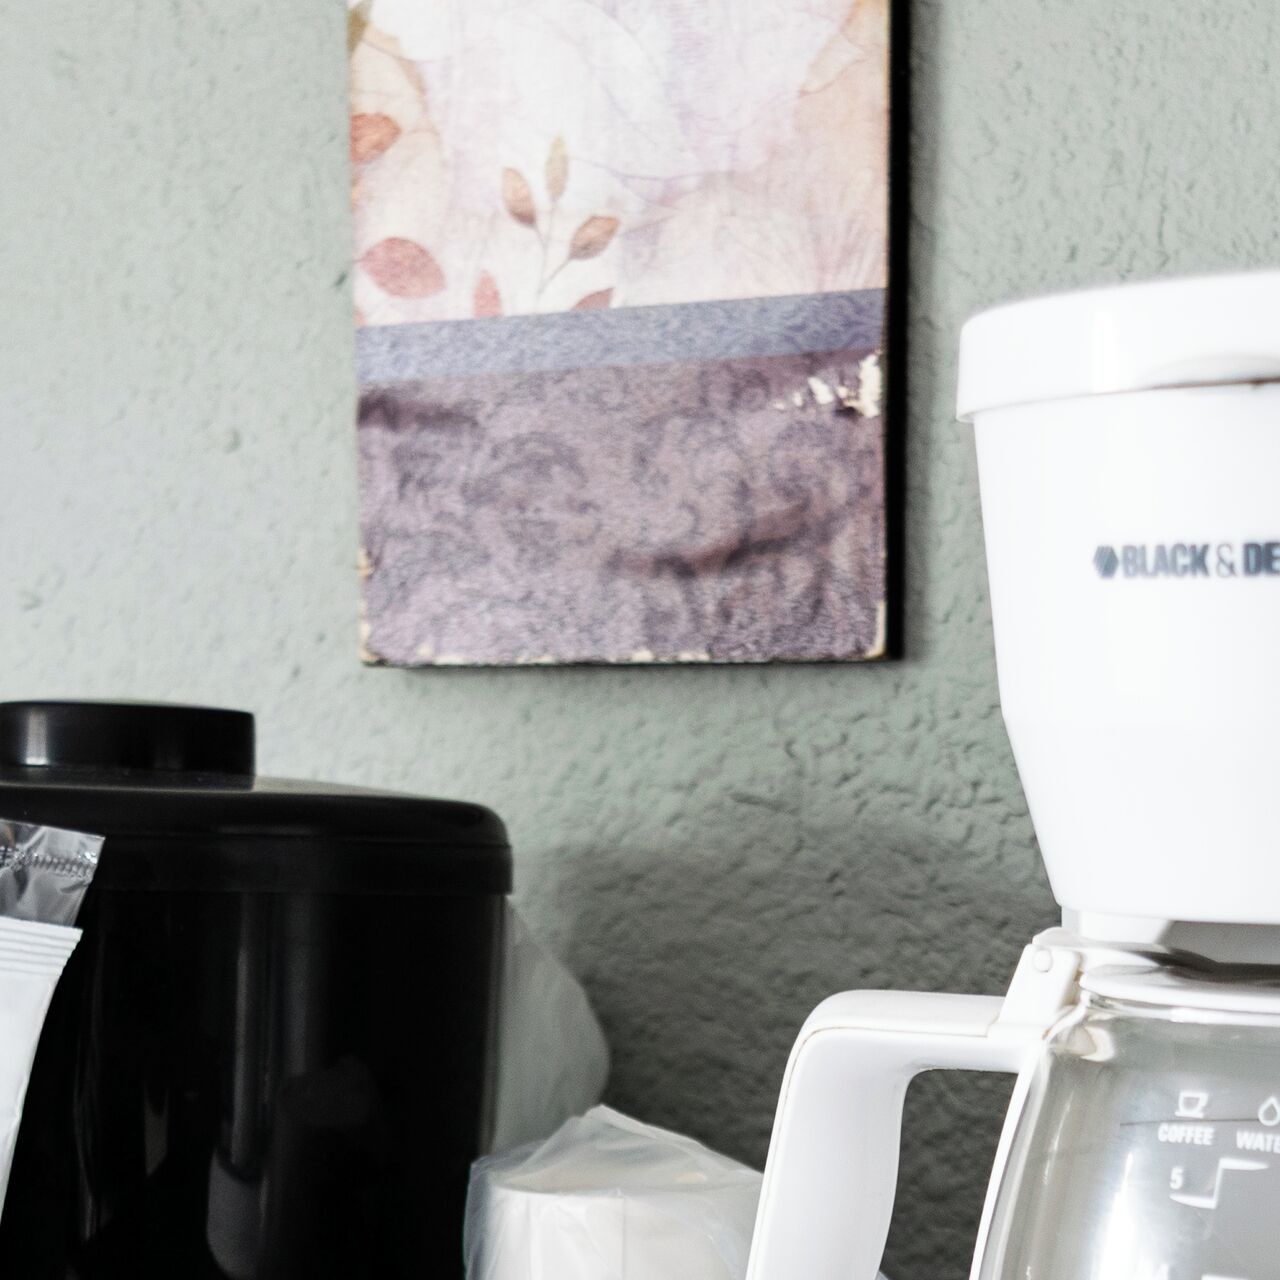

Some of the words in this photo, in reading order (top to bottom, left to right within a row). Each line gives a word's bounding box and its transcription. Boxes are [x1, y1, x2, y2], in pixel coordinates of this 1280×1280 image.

[1122, 542, 1210, 578] BLACK
[1215, 543, 1238, 578] &
[1157, 1123, 1215, 1146] COFFEE
[1169, 1165, 1184, 1190] 5
